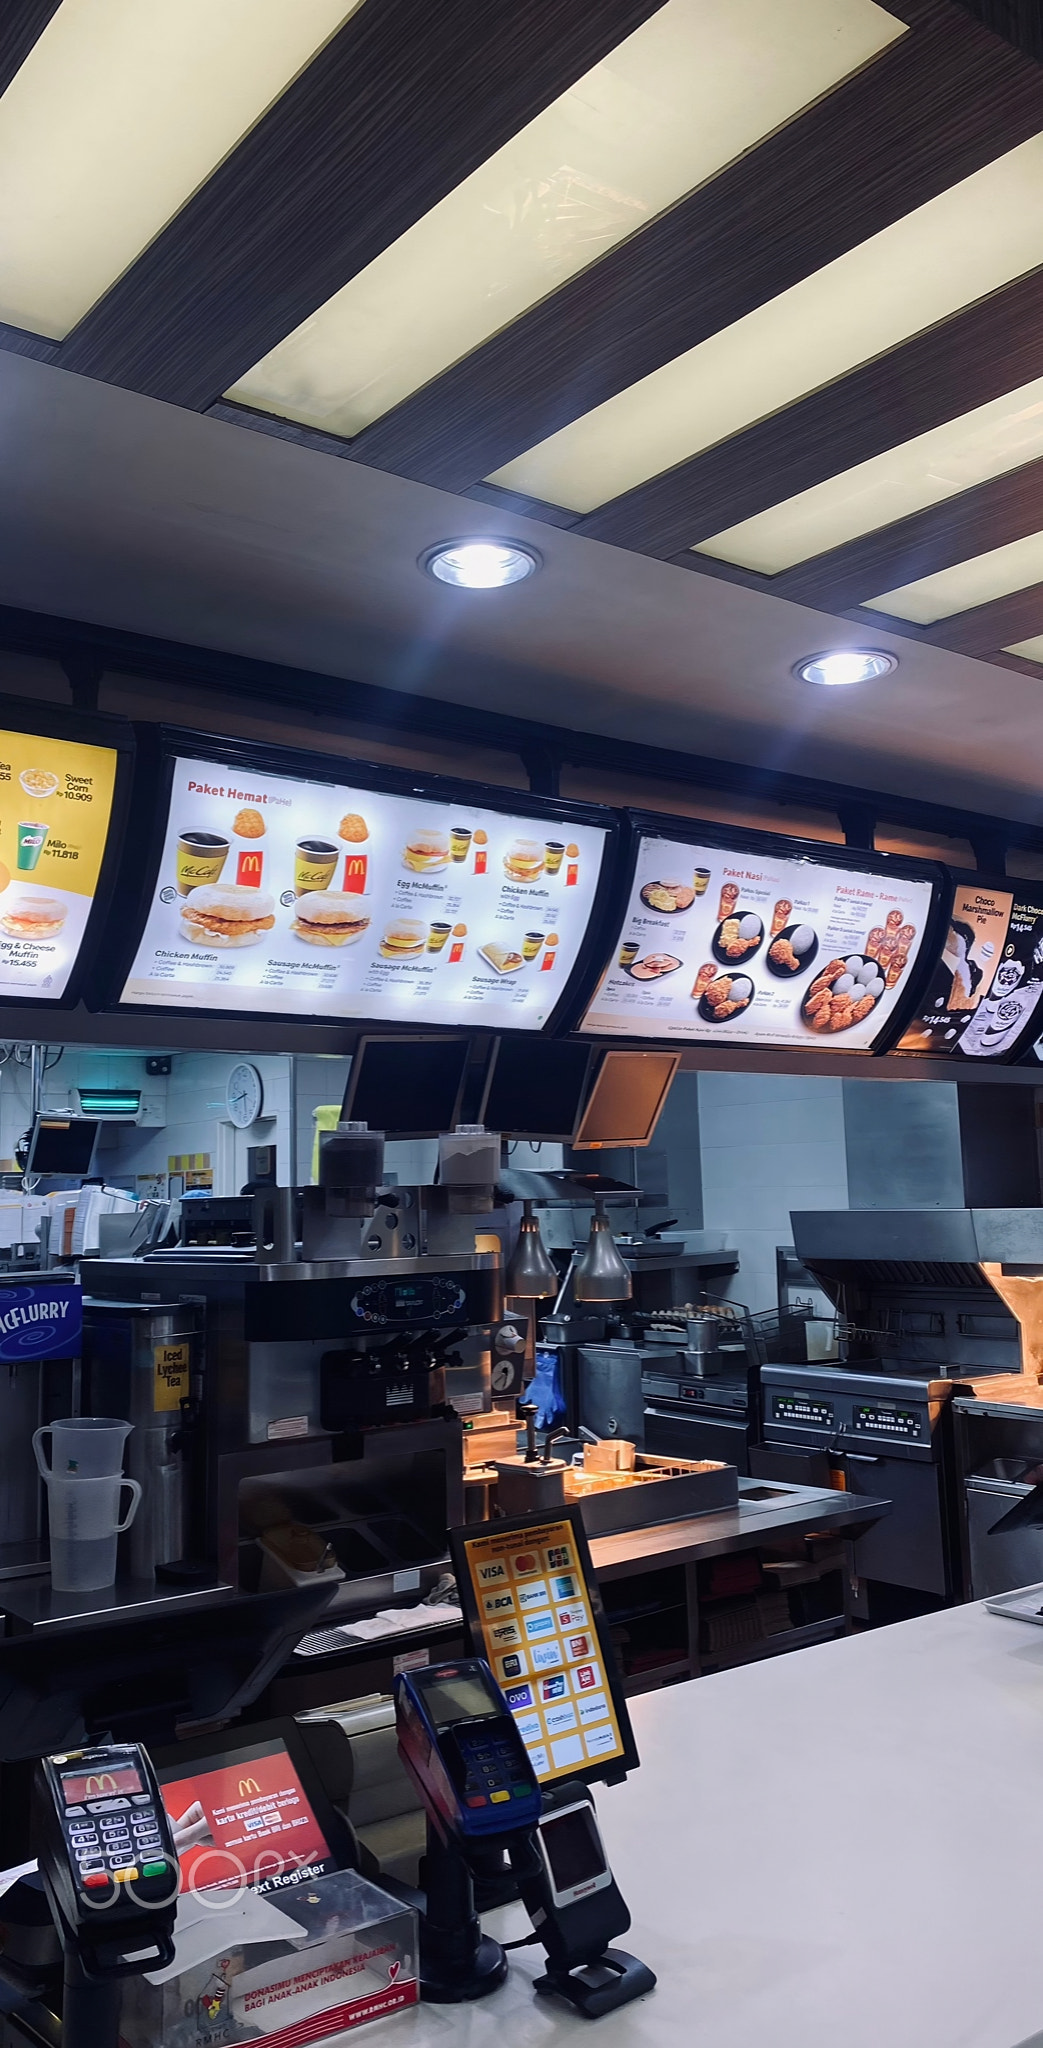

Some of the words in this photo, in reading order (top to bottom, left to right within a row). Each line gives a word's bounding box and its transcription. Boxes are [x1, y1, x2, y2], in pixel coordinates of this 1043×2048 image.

[65, 773, 93, 785] Sweet
[66, 782, 88, 793] Corn
[188, 781, 225, 796] Paket
[227, 787, 268, 804] Hemat
[47, 840, 67, 849] Milo
[722, 867, 744, 878] Paket
[745, 871, 763, 881] Nasi
[397, 880, 410, 889] Egg
[502, 886, 528, 895] Chicken
[529, 889, 549, 897] Muffin
[836, 886, 855, 896] Paket
[975, 896, 995, 906] Choco
[962, 904, 1004, 917] Marshmallow
[1013, 903, 1027, 912] Dark
[632, 916, 642, 925] Big
[642, 918, 670, 927] Breakfast
[976, 915, 987, 924] Pie
[0, 942, 12, 950] gg
[23, 943, 55, 952] Cheese
[9, 951, 38, 959] Muffin
[155, 950, 190, 960] Chicken
[190, 953, 218, 961] Muffin
[267, 960, 300, 969] Sausage
[370, 962, 400, 971] Sausage
[472, 976, 500, 984] Sausage
[500, 978, 517, 986] Wrap
[163, 1350, 183, 1361] Iced
[157, 1362, 188, 1378] Lychee
[166, 1375, 181, 1387] Tea
[480, 1565, 504, 1579] VISA
[494, 1596, 512, 1609] BCA
[509, 1692, 527, 1703] OVO
[215, 1814, 236, 1826] kartu
[247, 1820, 262, 1829] VISA
[246, 1881, 271, 1895] ext
[272, 1863, 325, 1888] Register
[244, 1979, 291, 2002] DONASIMU
[293, 1959, 351, 1985] MENCIPTAKAN
[244, 2000, 266, 2012] BAGI
[267, 1979, 319, 2004] ANAK-ANAK
[320, 1964, 366, 1985] INDONESIA
[195, 2028, 230, 2048] RMHC
